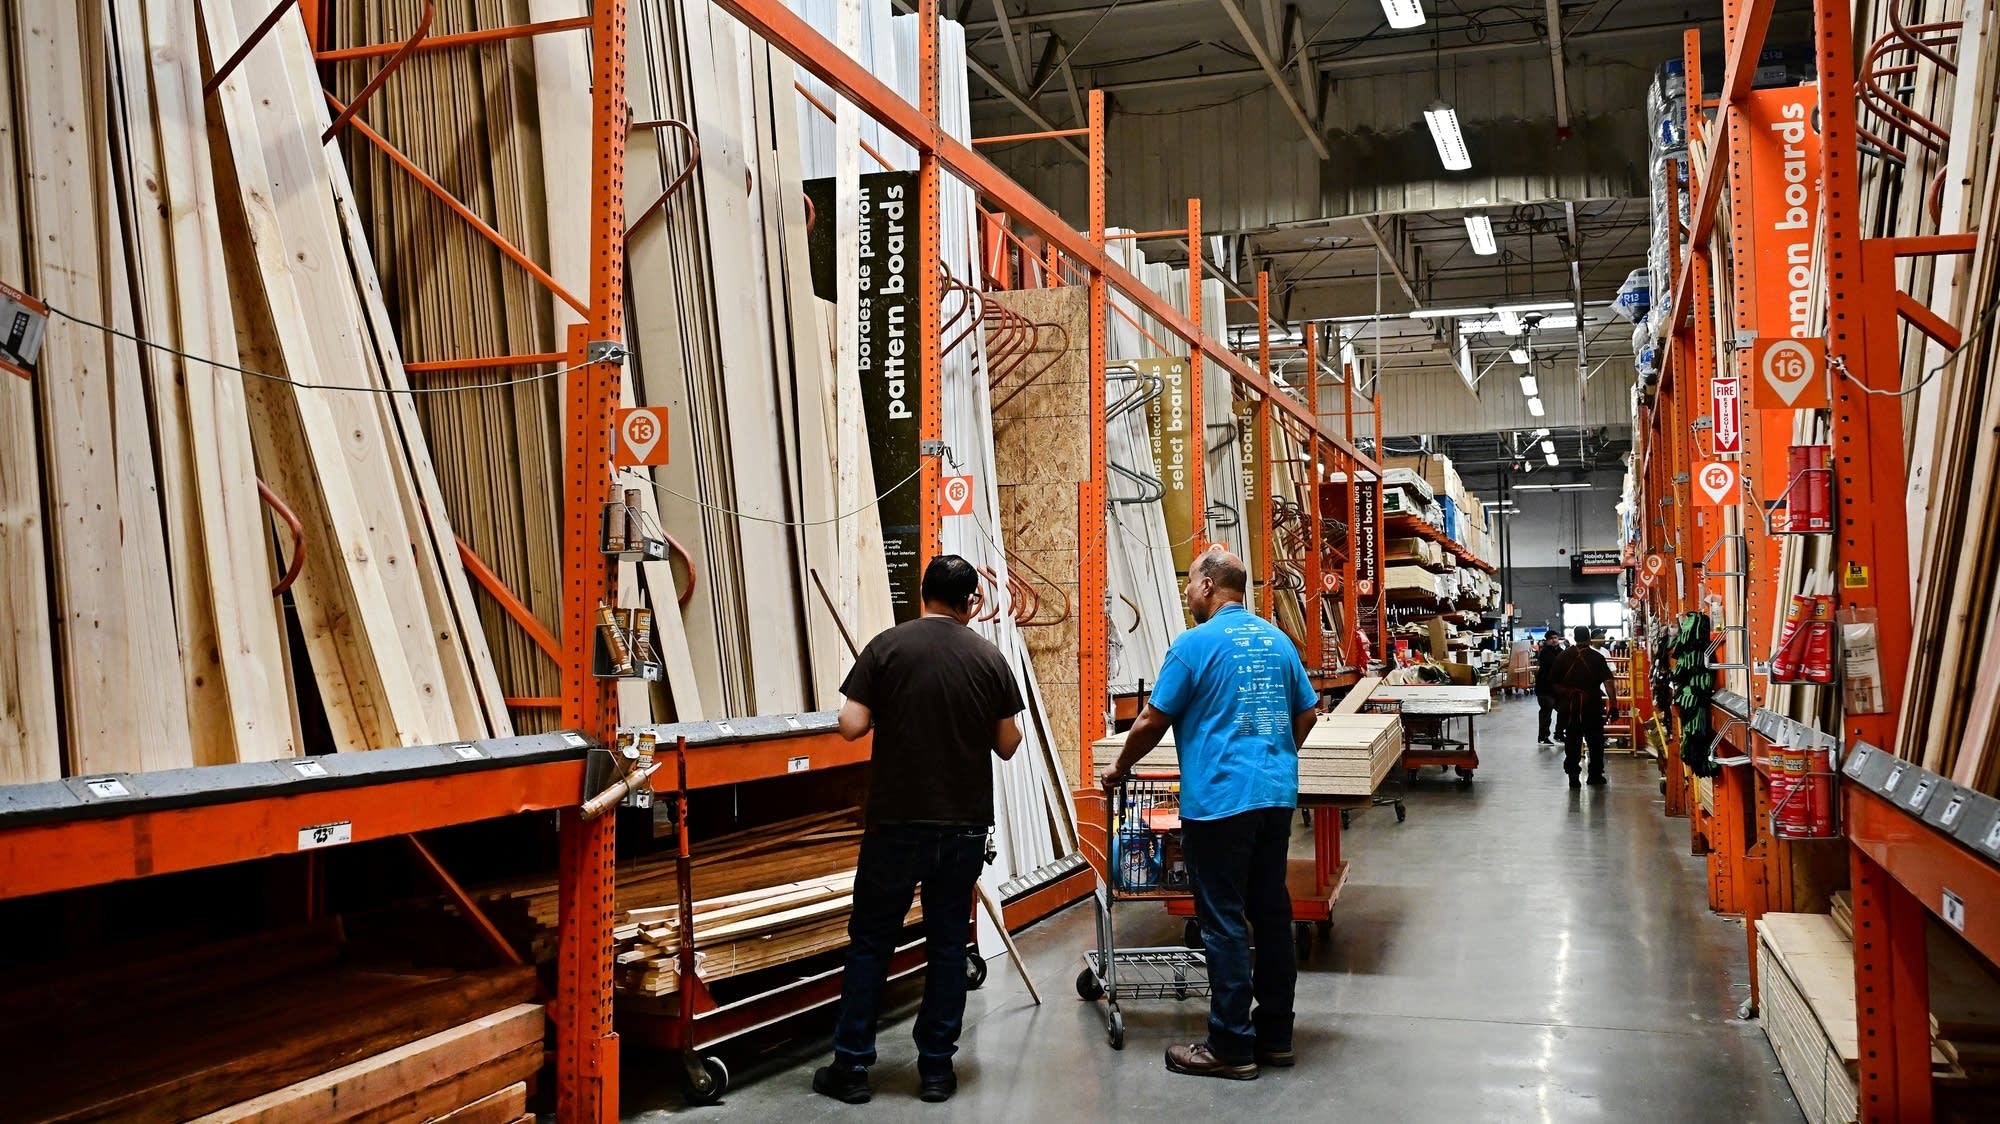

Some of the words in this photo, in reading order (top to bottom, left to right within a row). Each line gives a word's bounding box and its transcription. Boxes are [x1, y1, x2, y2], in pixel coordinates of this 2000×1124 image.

[1771, 103, 1808, 230] boards
[879, 185, 905, 294] boards
[859, 265, 871, 291] de
[1624, 294, 1639, 302] R13
[858, 297, 871, 370] bordes
[884, 305, 912, 419] pattern
[1775, 359, 1803, 378] 16
[1166, 364, 1183, 431] boards
[1716, 386, 1734, 396] FIRE
[631, 424, 652, 441] 13
[1239, 407, 1253, 464] boards
[1167, 437, 1184, 490] select
[1708, 474, 1725, 486] 14
[951, 487, 964, 499] 13
[1362, 486, 1373, 523] boards
